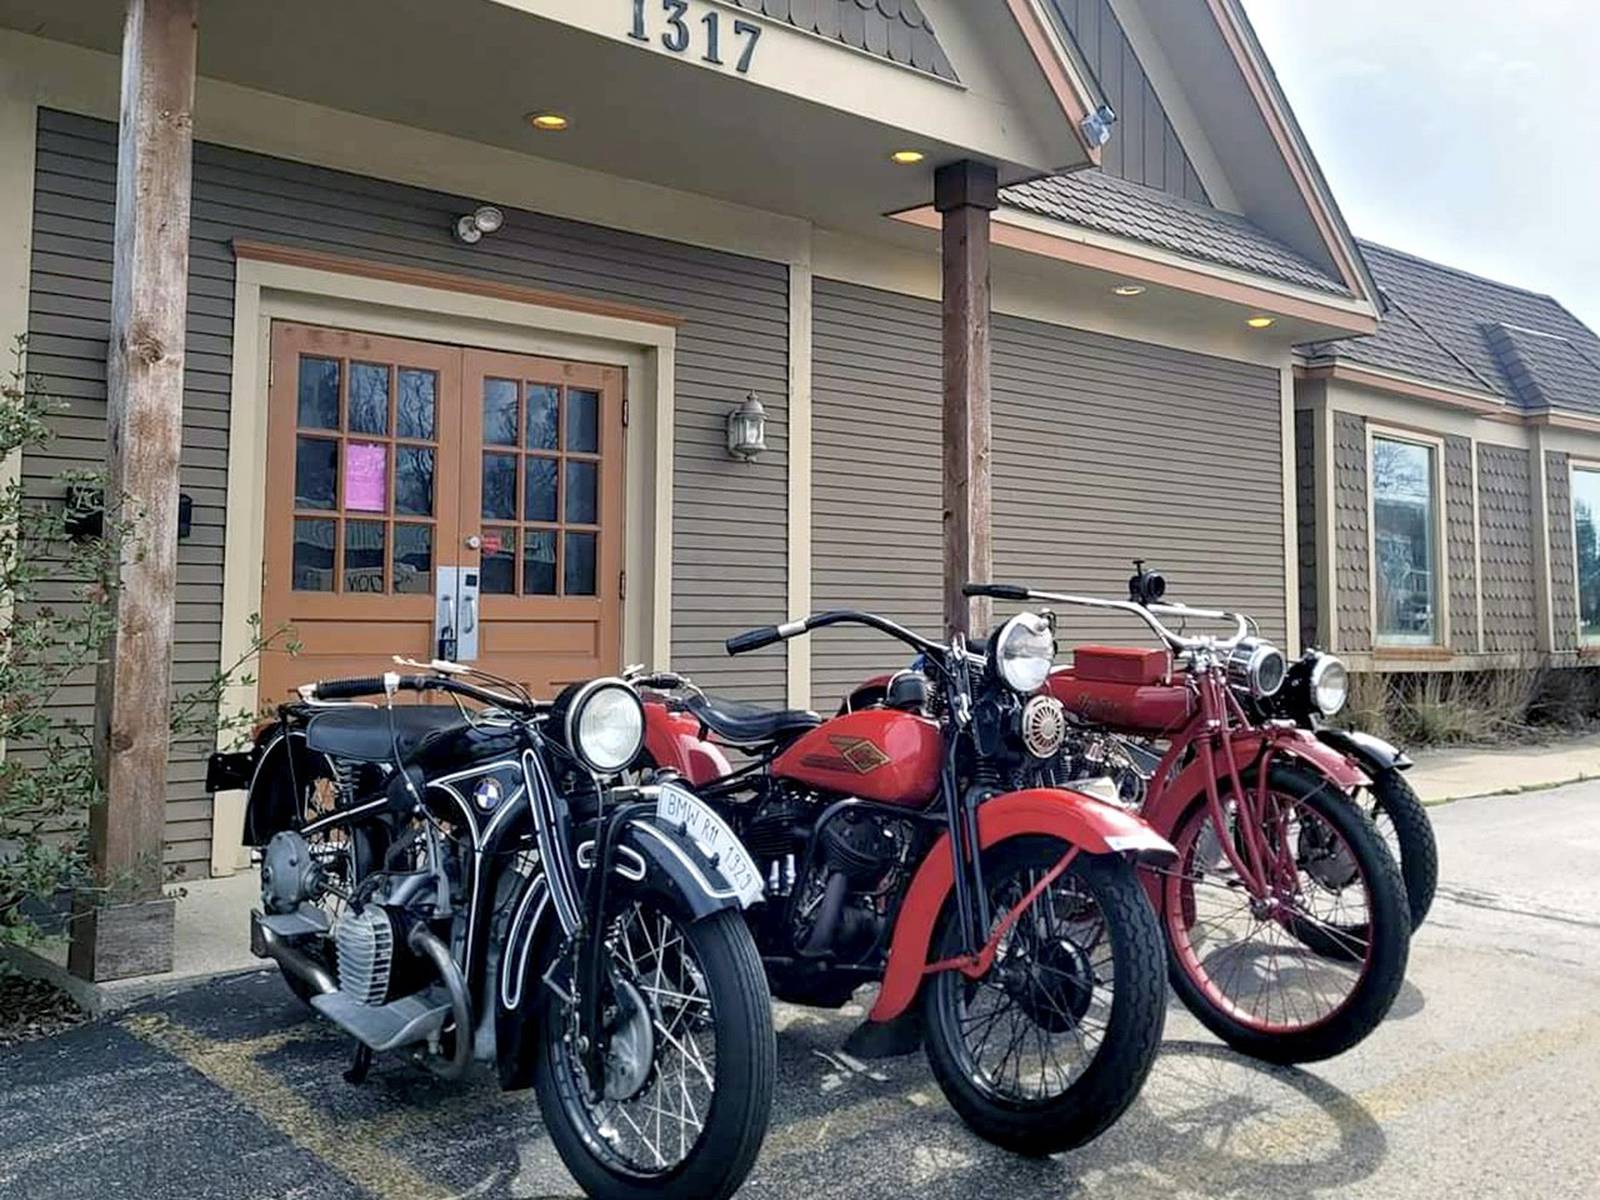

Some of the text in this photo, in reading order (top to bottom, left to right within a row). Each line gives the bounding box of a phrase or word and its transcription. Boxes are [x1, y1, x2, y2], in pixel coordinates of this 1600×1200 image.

[627, 0, 762, 73] 1317
[667, 793, 700, 826] BMW
[701, 818, 719, 845] R11
